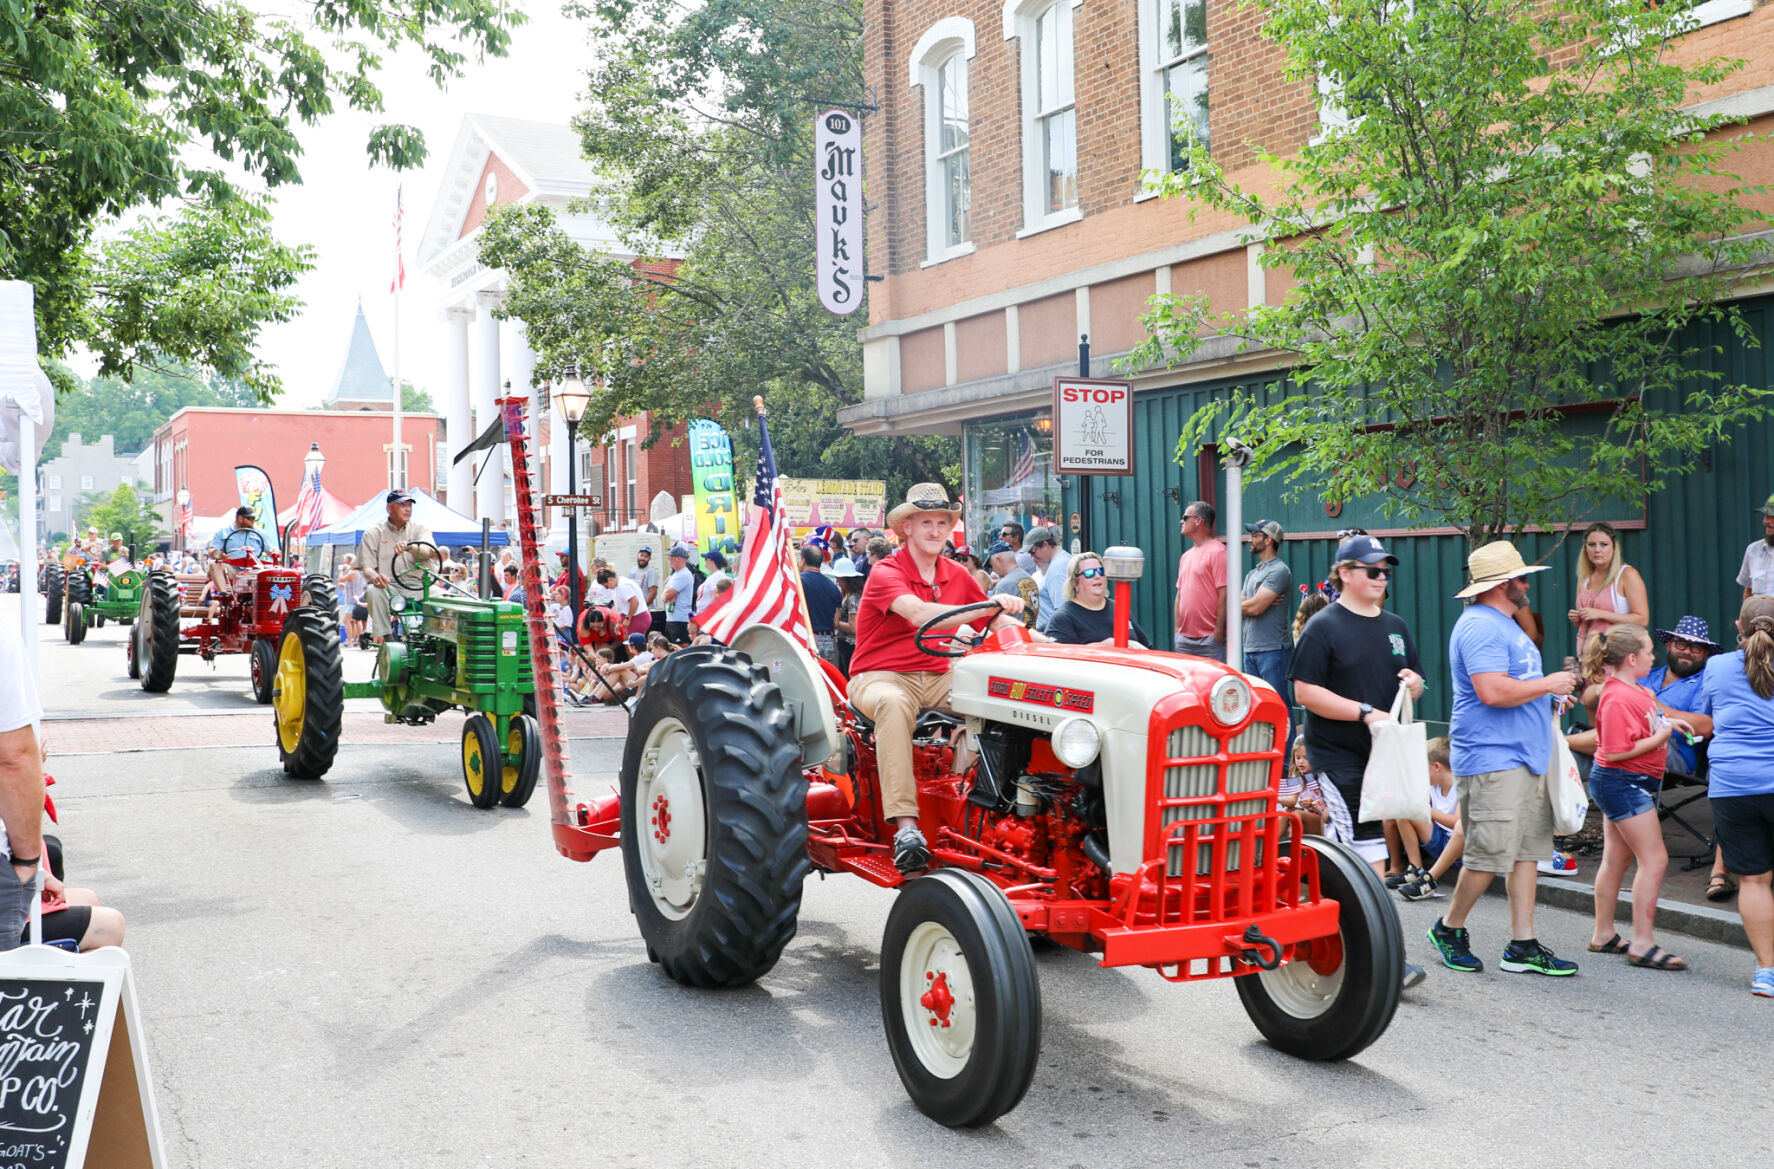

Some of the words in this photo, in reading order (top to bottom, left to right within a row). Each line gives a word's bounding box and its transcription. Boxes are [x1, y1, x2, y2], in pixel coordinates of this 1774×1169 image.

[830, 118, 847, 131] 101
[1063, 388, 1125, 403] STOP
[1063, 457, 1126, 466] PEDESTRIANS
[548, 496, 553, 504] S
[556, 496, 590, 505] Cherokee
[592, 496, 601, 505] St
[1024, 686, 1054, 703] SELECT
[1064, 692, 1092, 710] SPEED
[1012, 710, 1051, 725] DIESEL
